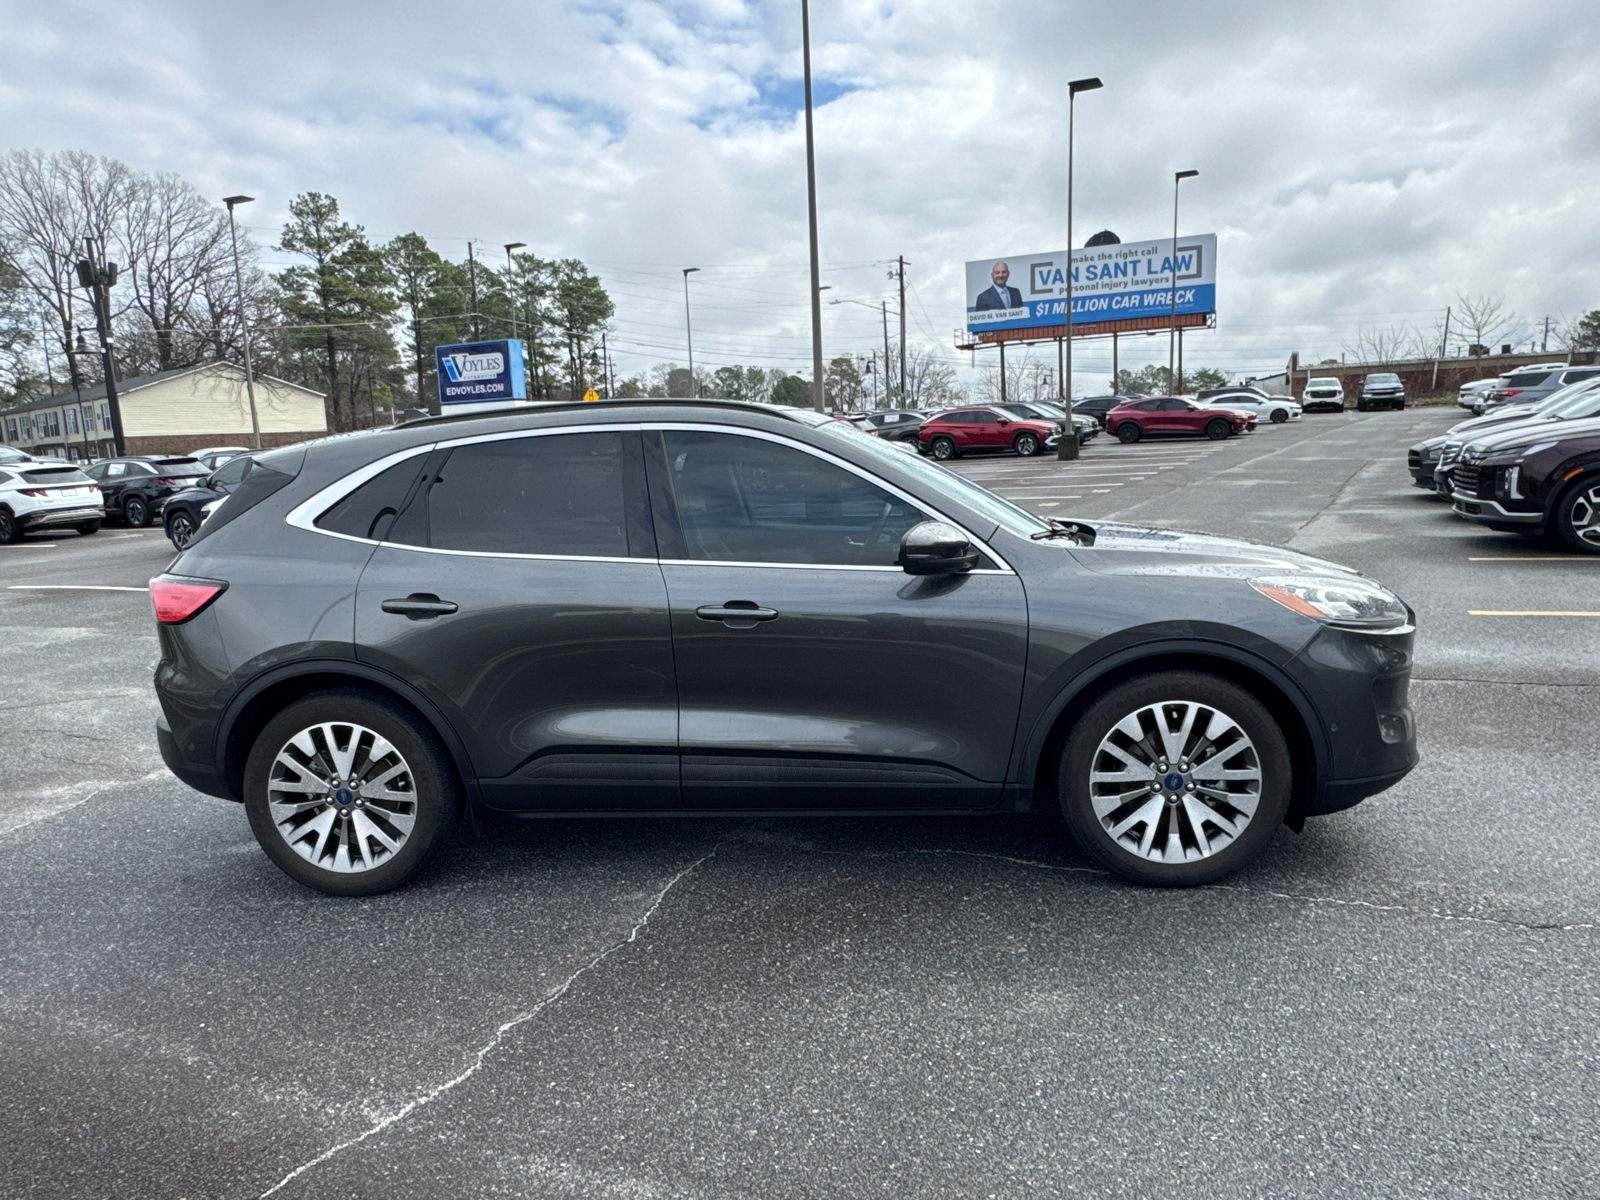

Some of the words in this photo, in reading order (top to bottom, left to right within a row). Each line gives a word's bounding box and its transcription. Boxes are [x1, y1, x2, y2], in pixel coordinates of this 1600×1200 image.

[1071, 254, 1095, 263] make
[1098, 252, 1112, 260] the
[1115, 249, 1138, 260] right
[1141, 246, 1158, 256] call
[1039, 266, 1079, 285] VAN
[1086, 259, 1141, 281] SANT
[1147, 254, 1193, 275] LAW
[1101, 280, 1128, 290] injury
[1131, 277, 1169, 287] lawyers
[1036, 302, 1049, 317] $1
[1052, 297, 1109, 315] MLLION
[1112, 294, 1140, 309] CAR
[1143, 289, 1196, 306] WRECK
[970, 314, 986, 322] DAVID
[451, 355, 501, 378] VOYLES
[446, 383, 505, 396] EDVOYLES.COM
